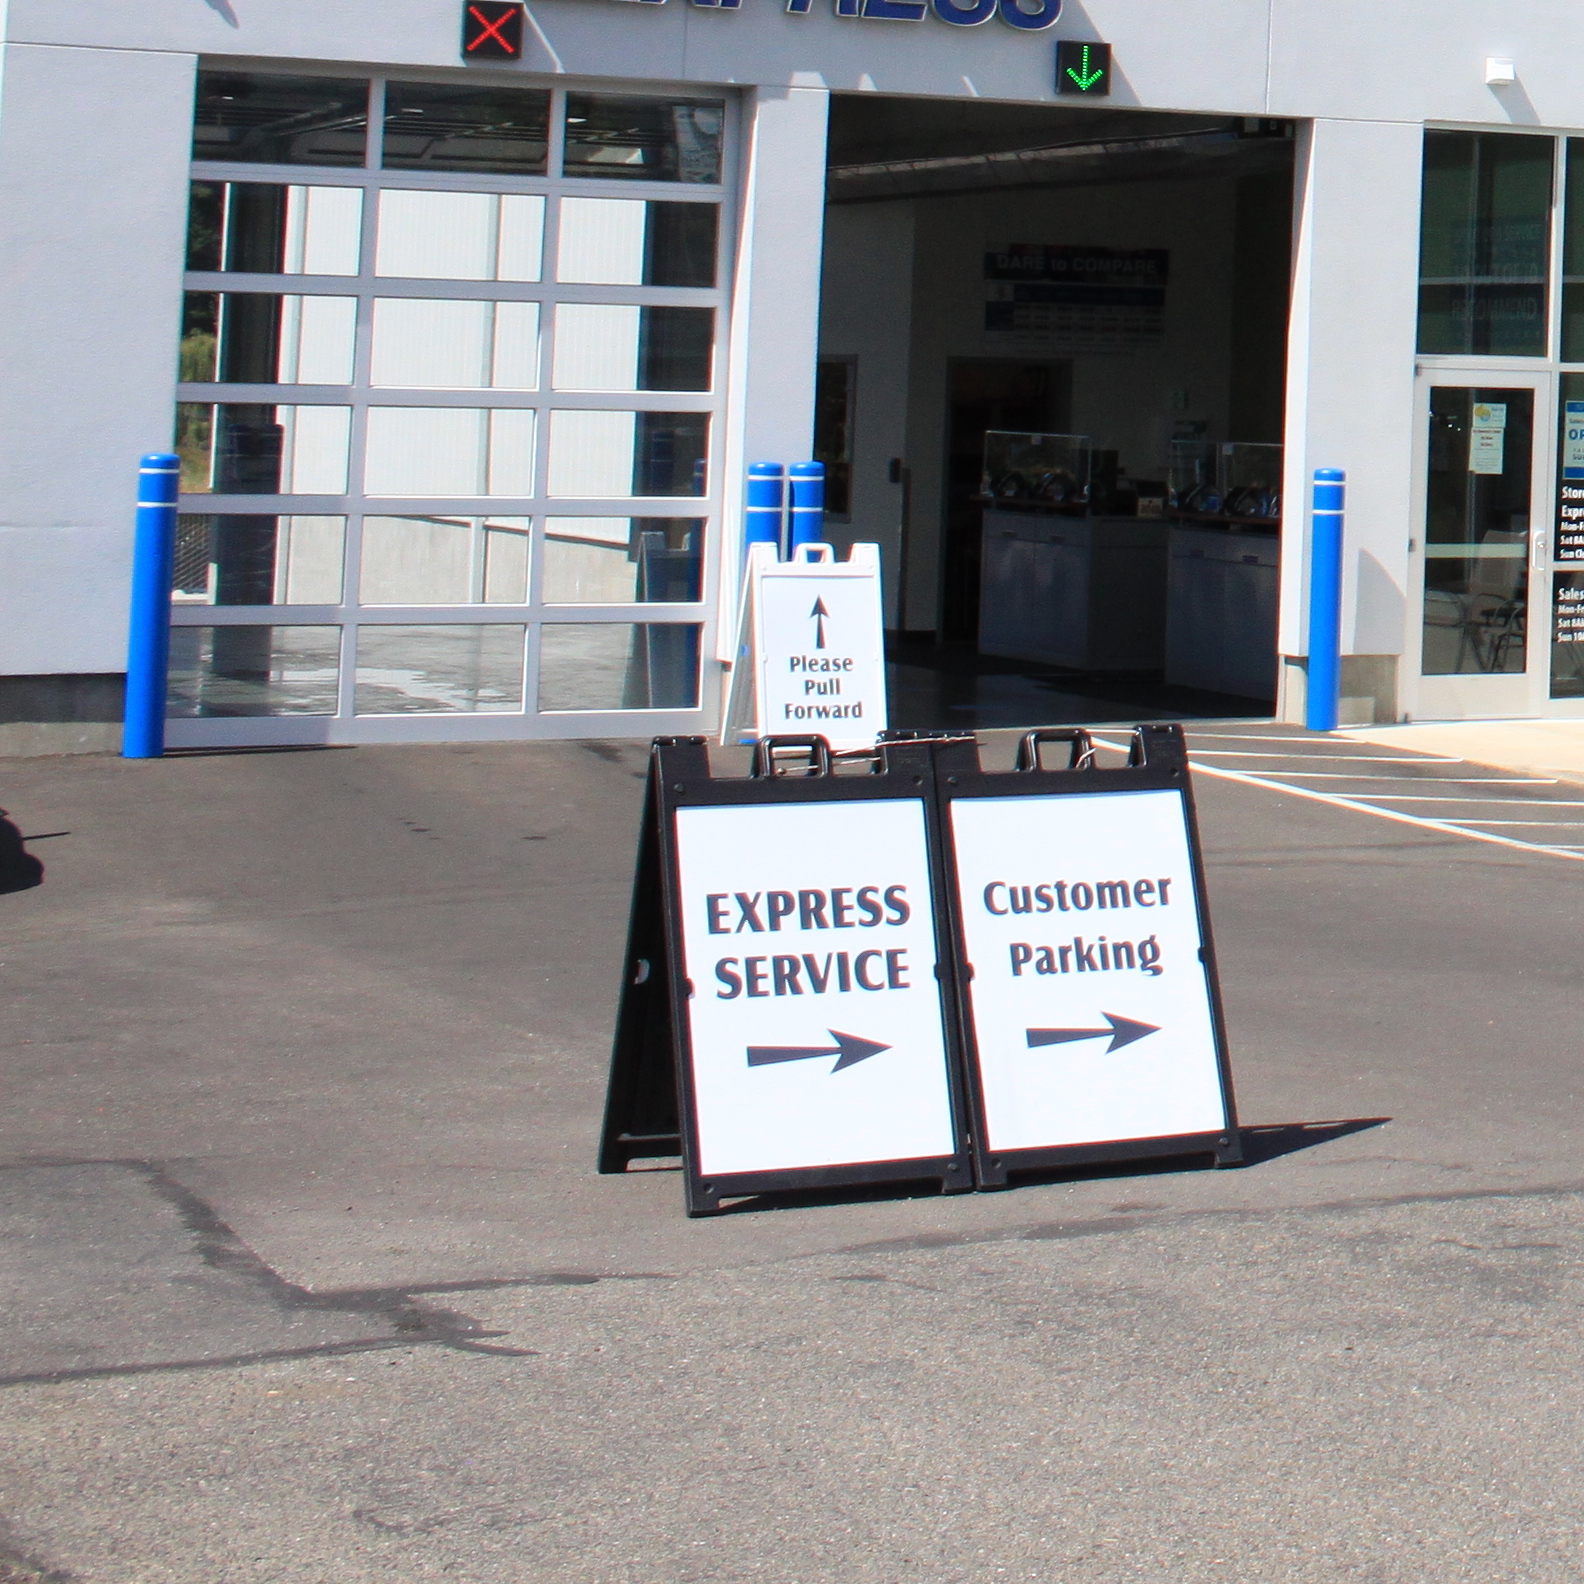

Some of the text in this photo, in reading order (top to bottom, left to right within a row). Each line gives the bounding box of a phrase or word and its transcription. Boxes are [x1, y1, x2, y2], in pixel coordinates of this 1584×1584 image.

[996, 254, 1045, 271] DARE
[1072, 257, 1158, 274] COMPARE
[1560, 535, 1573, 545] Sat
[1560, 549, 1574, 559] Sun
[1558, 587, 1584, 601] Sales
[1557, 617, 1571, 629] Sat
[1557, 632, 1572, 643] Sun
[788, 653, 854, 673] Please
[804, 677, 841, 697] Pull
[784, 700, 863, 721] Forward
[983, 875, 1172, 916] Customer
[706, 884, 911, 936] EXPRESS
[1009, 934, 1163, 977] Parking
[715, 948, 911, 1000] SERVICE
